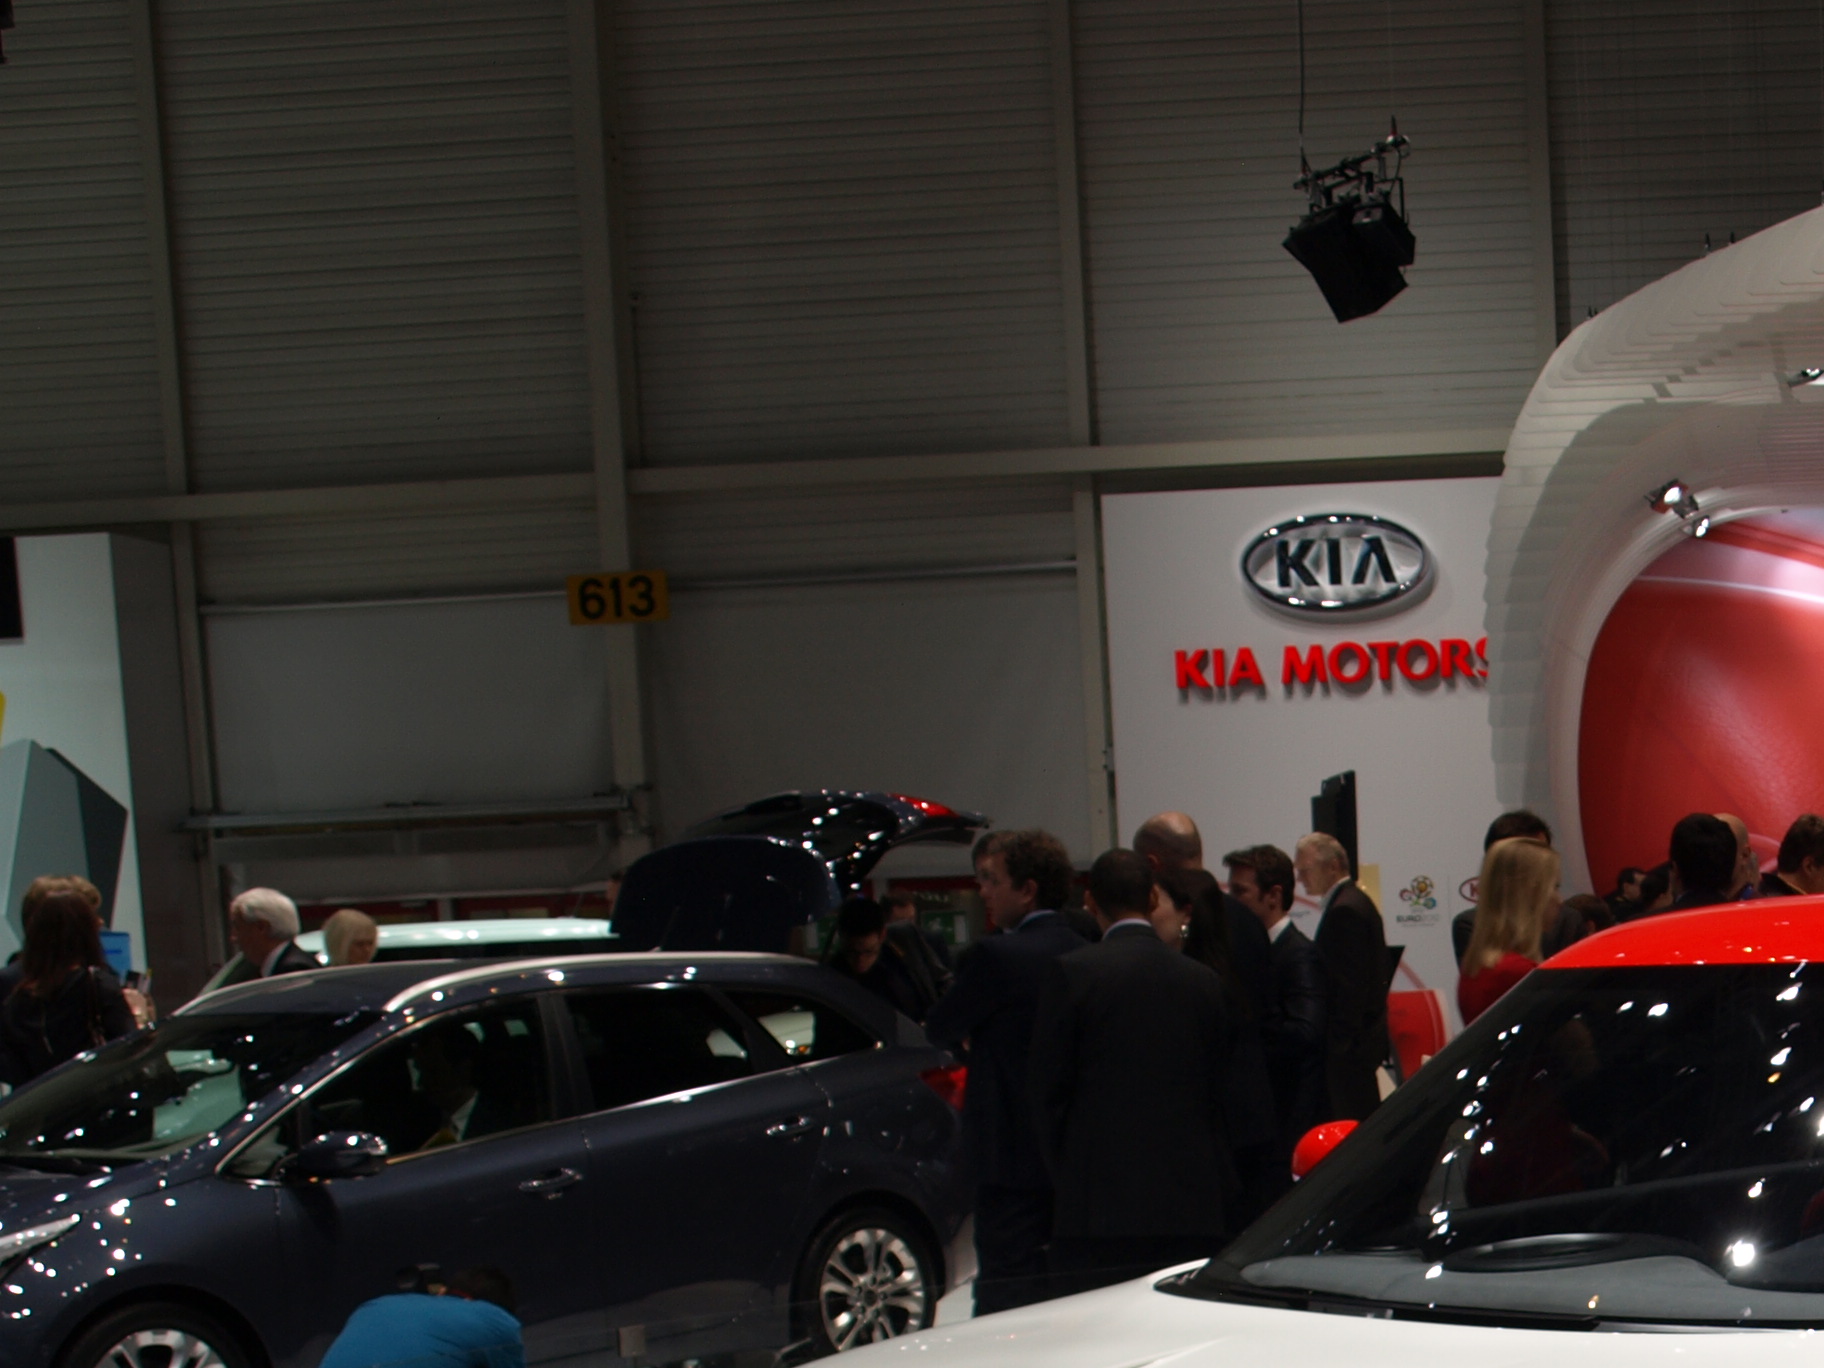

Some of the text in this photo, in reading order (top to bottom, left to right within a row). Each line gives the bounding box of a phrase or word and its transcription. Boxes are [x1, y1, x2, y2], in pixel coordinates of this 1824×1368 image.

[1276, 535, 1397, 587] KIA
[578, 574, 655, 620] 613
[1175, 647, 1264, 689] KIA
